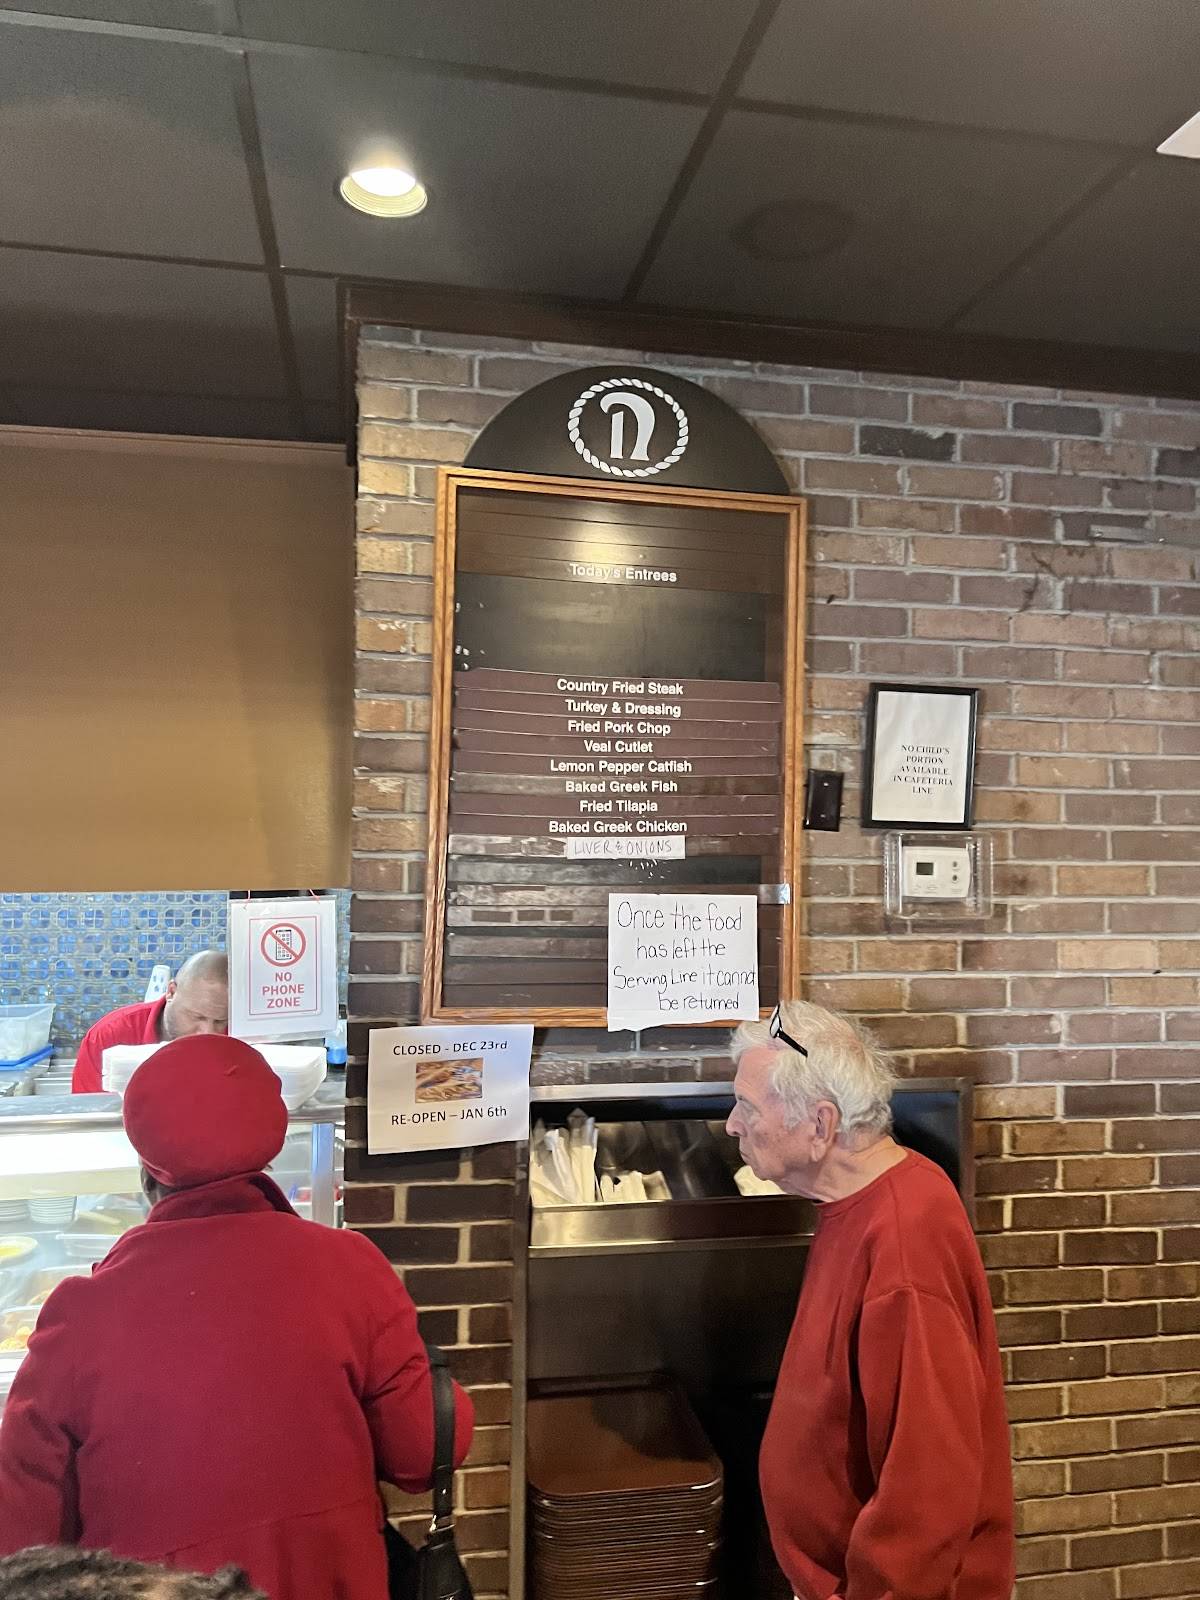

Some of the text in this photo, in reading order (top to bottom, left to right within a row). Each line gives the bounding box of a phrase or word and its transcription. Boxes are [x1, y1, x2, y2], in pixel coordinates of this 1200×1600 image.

[570, 563, 677, 582] Today's Entrees
[557, 679, 683, 695] Country Fried Steak
[565, 699, 681, 717] Turkey & Dressing
[568, 720, 670, 735] Fried Pork Chop
[584, 740, 653, 752] Veal Cutlet
[906, 755, 943, 764] PORTION
[551, 760, 692, 774] Lemon Pepper Catfish
[900, 766, 950, 775] AVAILABLE
[566, 781, 677, 792] Baked Greek Fish
[904, 776, 953, 785] CAFETERIA
[912, 786, 933, 794] LINE
[580, 801, 658, 814] Fried Tilapia
[549, 821, 687, 833] Baked Greek Chicken
[574, 840, 610, 855] LIVER
[627, 840, 672, 855] ONIONS
[617, 901, 742, 931] Once the food
[637, 937, 726, 959] has left the
[275, 972, 292, 982] NO
[614, 966, 667, 993] Serving
[262, 984, 304, 995] PHONE
[268, 997, 300, 1008] ZONE
[658, 990, 679, 1011] be
[393, 1044, 441, 1055] CLOSED
[453, 1042, 477, 1052] DEC
[481, 1041, 507, 1050] 23rd
[392, 1111, 446, 1125] RE-OPEN
[460, 1108, 483, 1119] JAN
[487, 1106, 507, 1117] 6th
